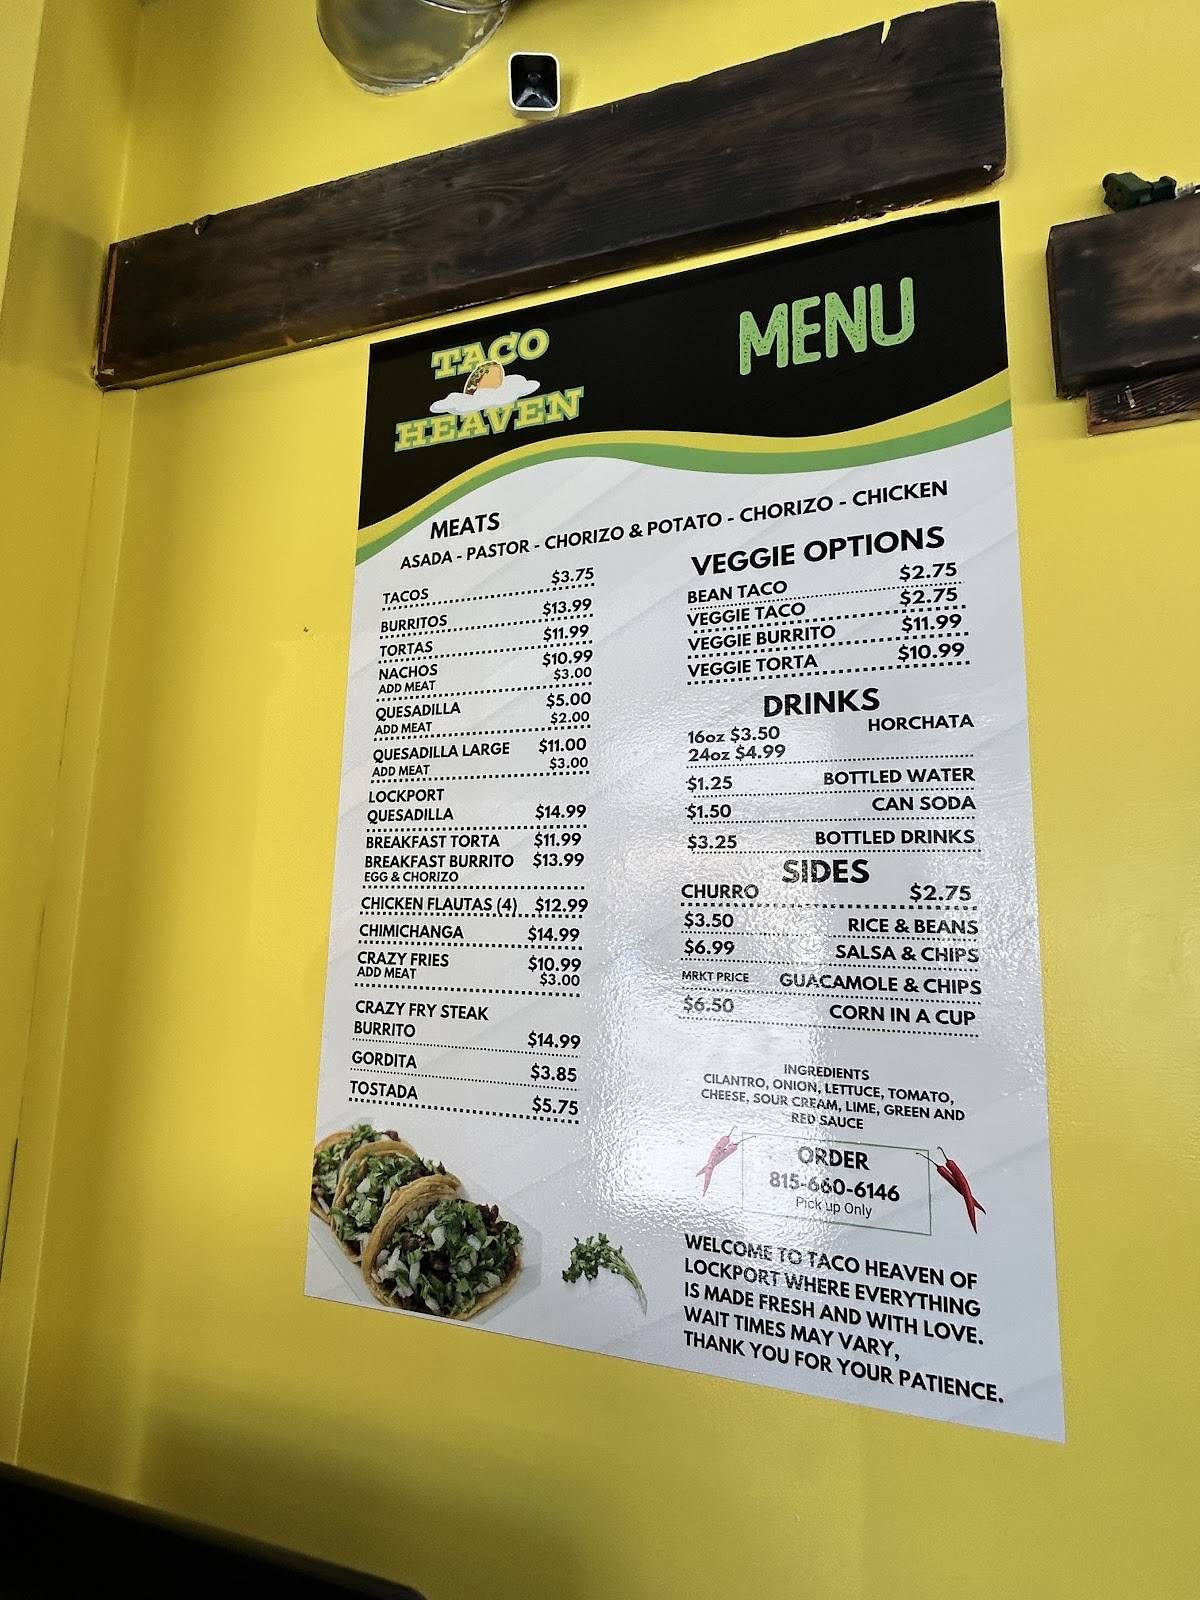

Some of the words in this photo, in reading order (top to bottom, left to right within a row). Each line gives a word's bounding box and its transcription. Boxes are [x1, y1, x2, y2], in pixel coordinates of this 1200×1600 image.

[739, 277, 915, 376] MENU
[431, 328, 550, 379] TACO
[395, 386, 584, 452] HEAVEN
[400, 550, 453, 570] ASADA
[467, 539, 530, 561] PASTOR
[544, 526, 624, 549] CHORIZO
[629, 524, 643, 538] &
[647, 512, 722, 536] POTATO
[739, 495, 833, 523] CHORIZO
[852, 480, 948, 507] CHICKEN
[430, 512, 500, 539] MEATS
[691, 543, 795, 576] VEGGIE
[803, 526, 945, 562] OPTIONS
[383, 588, 429, 606] TACOS
[551, 567, 594, 585] $3.75
[688, 586, 734, 604] BEAN
[737, 581, 788, 599] TACO
[899, 562, 957, 582] $2.75
[380, 615, 448, 633] BURRITOS
[543, 598, 593, 617] $13.99
[687, 609, 750, 627] VEGGIE
[754, 602, 806, 620] TACO
[899, 587, 958, 607] $2.75
[380, 641, 433, 658] TORTAS
[543, 624, 590, 642] $11.99
[688, 633, 752, 651] VEGGIE
[756, 625, 836, 645] BURRITO
[901, 613, 962, 633] $11.99
[379, 664, 438, 680] NACHOS
[542, 649, 593, 667] $10.99
[688, 660, 752, 678] VEGGIE
[756, 654, 818, 671] TORTA
[897, 642, 965, 662] $10.99
[378, 682, 402, 694] ADD
[404, 681, 436, 692] MEAT
[553, 667, 592, 681] $3.00
[376, 702, 461, 721] QUESADILLA
[546, 692, 591, 708] $5.00
[763, 687, 880, 718] DRINKS
[375, 723, 399, 735] ADD
[401, 722, 432, 733] MEAT
[550, 711, 590, 725] $2.00
[688, 730, 725, 744] 16oz
[730, 725, 780, 743] $3.50
[868, 714, 974, 732] HORCHATA
[373, 745, 459, 763] QUESADILLA
[462, 742, 510, 756] LARGE
[539, 737, 587, 754] $11.00
[688, 748, 730, 762] 24oz
[735, 744, 786, 761] $4.99
[372, 766, 396, 778] ADD
[398, 765, 430, 776] MEAT
[549, 757, 589, 770] $3.00
[687, 776, 733, 792] $1.25
[823, 770, 902, 786] BOTTLED
[907, 768, 975, 783] WATER
[368, 789, 445, 803] LOCKPORT
[686, 804, 732, 820] $1.50
[872, 797, 914, 811] CAN
[919, 796, 976, 810] SODA
[367, 808, 454, 823] QUESADILLA
[535, 805, 587, 820] $14.99
[366, 835, 448, 849] BREAKFAST
[451, 834, 500, 848] TORTA
[534, 833, 582, 848] $11.99
[687, 835, 737, 851] $3.25
[815, 831, 896, 845] BOTTLED
[901, 829, 975, 844] DRINKS
[365, 855, 447, 868] BREAKFAST
[449, 854, 514, 868] BURRITO
[533, 853, 585, 868] $13.99
[782, 859, 870, 884] SIDES
[364, 872, 389, 882] EGG
[390, 872, 401, 882] &
[403, 872, 459, 882] CHORIZO
[681, 884, 759, 900] CHURRO
[909, 884, 972, 902] $2.75
[361, 897, 424, 910] CHICKEN
[427, 897, 492, 911] FLAUTAS
[496, 897, 517, 916] (4)
[535, 898, 589, 914] $12.99
[359, 924, 464, 940] CHIMICHANGA
[527, 927, 580, 942] $14.99
[684, 912, 734, 929] $3.50
[848, 918, 889, 933] RICE
[894, 919, 910, 934] &
[914, 920, 978, 935] BEANS
[357, 951, 407, 966] CRAZY
[410, 953, 449, 967] FRIES
[528, 956, 582, 972] $10.99
[684, 939, 735, 957] $6.99
[835, 945, 896, 961] SALSA
[901, 946, 916, 961] &
[920, 947, 980, 963] CHIPS
[357, 967, 382, 978] ADD
[384, 968, 417, 979] MEAT
[539, 973, 580, 987] $3.00
[779, 973, 898, 992] GUACAMOLE
[903, 977, 919, 992] &
[923, 978, 982, 995] CHIPS
[355, 1000, 406, 1016] CRAZY
[408, 1003, 437, 1018] FRY
[440, 1005, 489, 1020] STEAK
[829, 1004, 885, 1021] CORN
[890, 1007, 910, 1022] IN
[915, 1008, 931, 1023] A
[935, 1008, 976, 1026] CUP
[354, 1021, 416, 1038] BURRITO
[527, 1031, 581, 1050] $14.99
[352, 1051, 417, 1069] GORDITA
[530, 1064, 577, 1083] $3.85
[784, 1064, 870, 1081] INGREDIENTS
[350, 1081, 418, 1100] TOSTADA
[532, 1095, 579, 1116] $5.75
[703, 1074, 769, 1091] CILANTRO,
[772, 1079, 822, 1095] ONION,
[824, 1082, 885, 1100] LETTUCE,
[888, 1088, 954, 1106] TOMATO,
[701, 1089, 750, 1103] CHEESE,
[753, 1092, 789, 1106] SOUR
[791, 1096, 842, 1113] CREAM,
[845, 1100, 881, 1116] LIME,
[884, 1104, 931, 1119] GREEN
[933, 1108, 966, 1122] AND
[818, 1116, 864, 1130] SAUCE
[797, 1146, 870, 1171] ORDER
[769, 1172, 900, 1202] 815-660-6146
[685, 1234, 774, 1261] WELCOME
[777, 1247, 802, 1265] TO
[809, 1251, 860, 1274] TACO
[865, 1260, 945, 1285] HEAVEN
[949, 1272, 978, 1290] OF
[685, 1258, 782, 1286] LOCKPORT
[784, 1272, 851, 1298] WHERE
[855, 1282, 981, 1317] EVERYTHING
[685, 1282, 701, 1299] IS
[704, 1285, 755, 1308] MADE
[759, 1293, 815, 1318] FRESH
[819, 1304, 862, 1325] AND
[866, 1311, 918, 1334] WITH
[924, 1319, 985, 1346] LOVE.
[684, 1306, 728, 1328] WAIT
[734, 1314, 786, 1338] TIMES
[791, 1325, 835, 1346] MAY
[838, 1333, 900, 1361] VARY,
[684, 1330, 746, 1356] THANK
[750, 1342, 791, 1364] YOU
[795, 1351, 833, 1373] FOR
[836, 1359, 893, 1385] YOUR
[899, 1370, 1004, 1404] PATIENCE.
